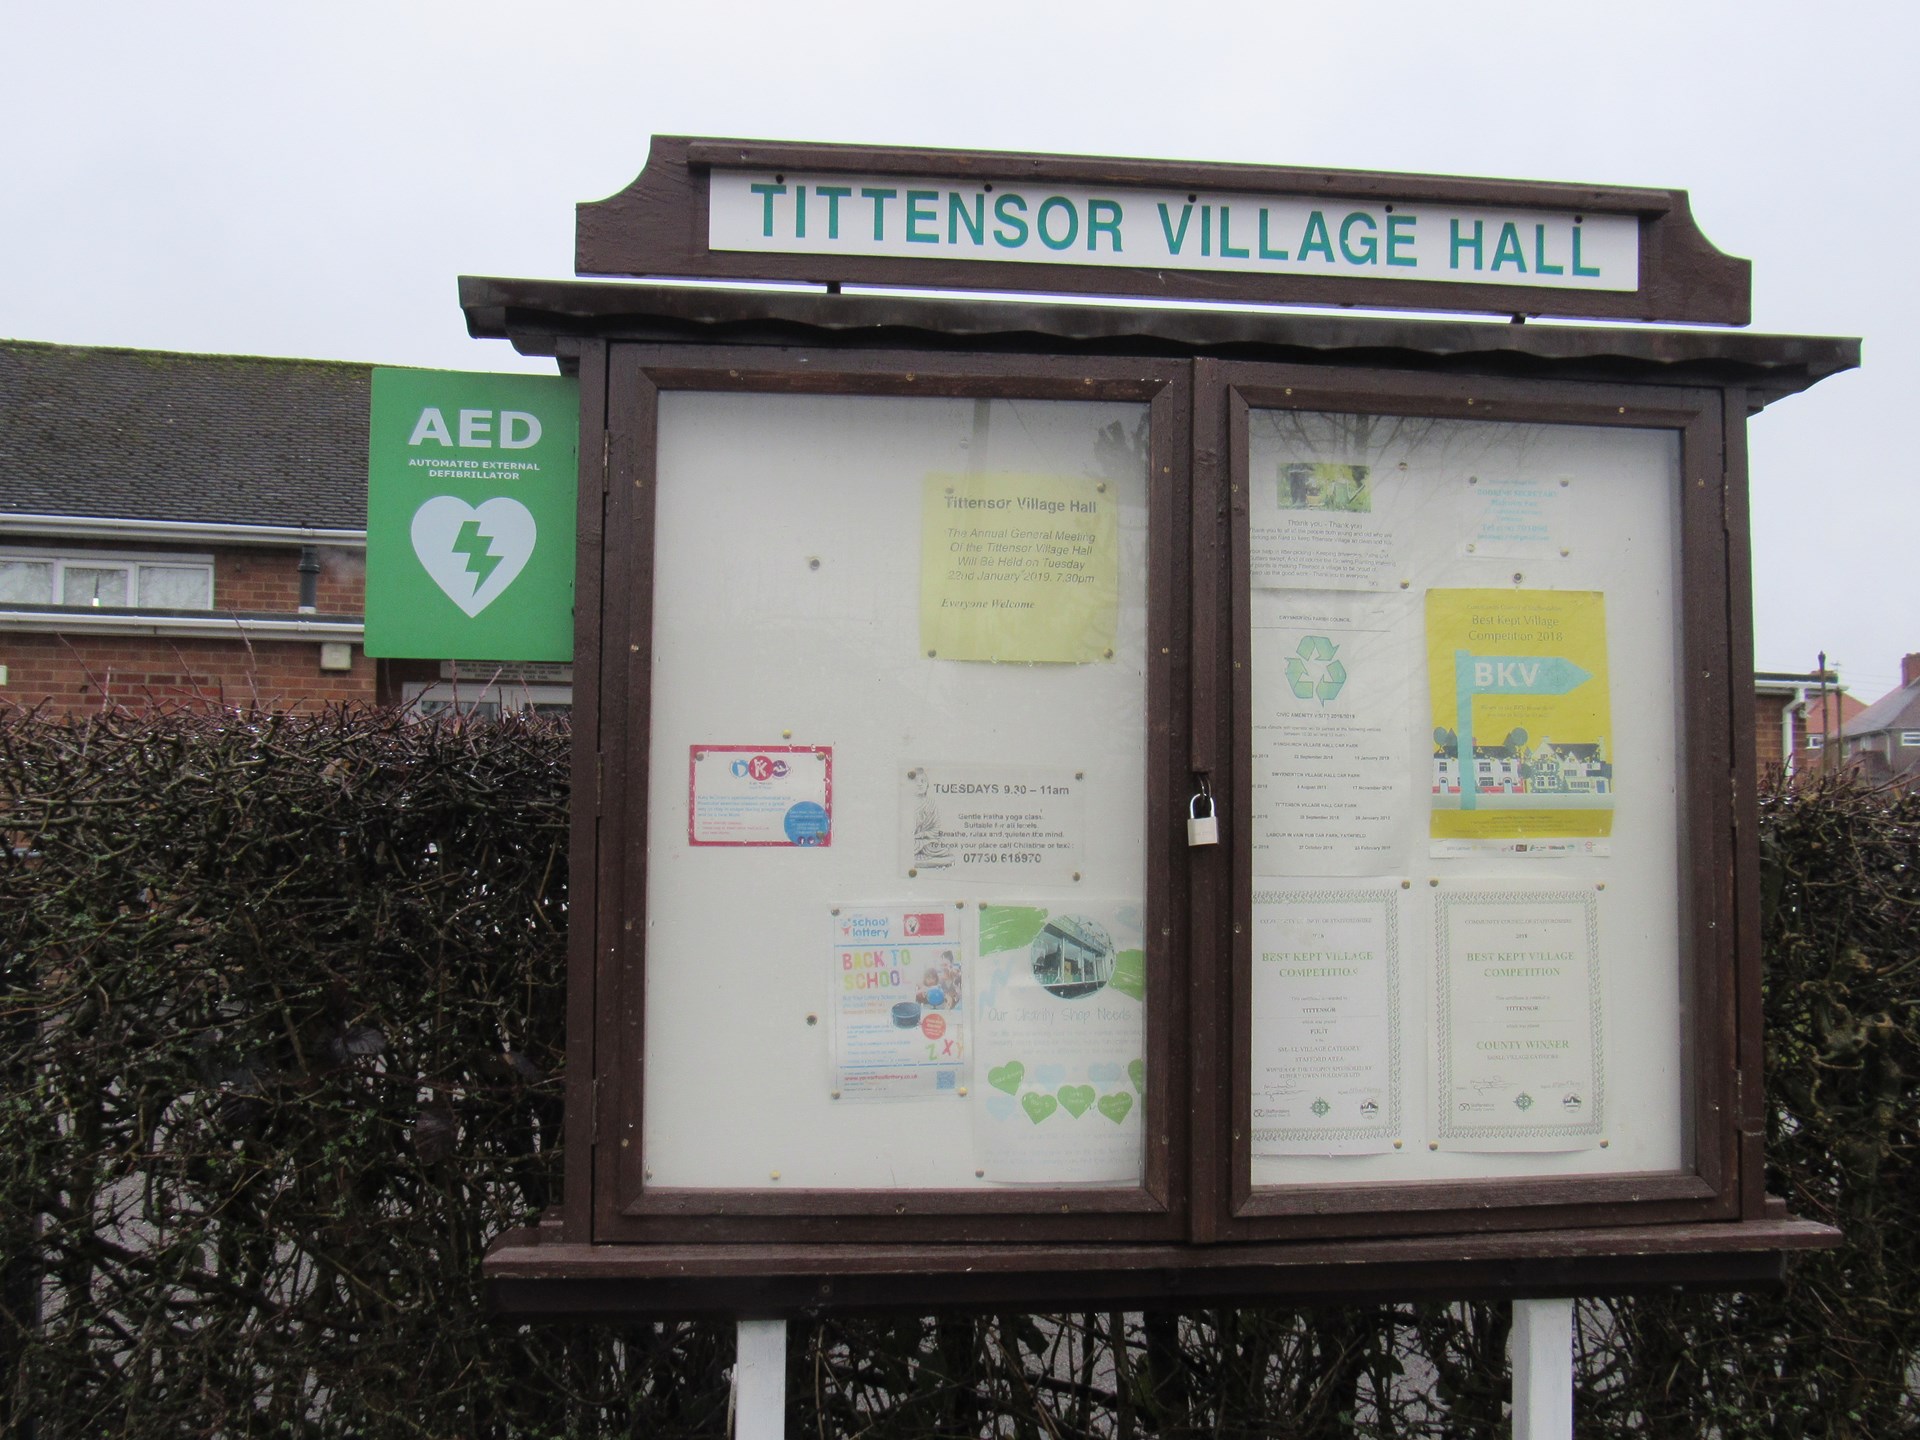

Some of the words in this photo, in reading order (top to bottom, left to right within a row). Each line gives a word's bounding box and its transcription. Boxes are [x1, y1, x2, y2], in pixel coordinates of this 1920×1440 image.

[750, 182, 1124, 252] TITTENSOR
[1156, 202, 1418, 268] VILLAGE
[1450, 218, 1600, 278] HALL
[408, 408, 542, 450] AED
[408, 458, 479, 470] AUTOMATED
[482, 460, 540, 472] EXTERNAL
[428, 470, 520, 480] DEFIBRILLATOR
[944, 496, 1012, 510] Tittensor
[1016, 496, 1066, 514] Village
[1070, 500, 1096, 514] Hall
[948, 528, 967, 538] The
[970, 528, 1008, 538] Annual
[1010, 528, 1053, 540] General
[1055, 530, 1096, 544] Meeting
[950, 542, 961, 552] Of
[966, 542, 983, 552] the
[986, 542, 1032, 553] Tittensor
[1036, 544, 1068, 556] Village
[1072, 545, 1093, 556] Hall
[958, 557, 976, 567] Will
[980, 557, 994, 567] Be
[998, 557, 1022, 567] Held
[1026, 559, 1038, 568] on
[1042, 558, 1085, 572] Tuesday
[947, 570, 974, 581] 22nd
[977, 571, 1020, 583] January
[1056, 572, 1095, 584] 7.30pm
[941, 598, 988, 610] Everyone
[991, 599, 1036, 609] Welcome
[1472, 615, 1494, 625] Best
[1497, 616, 1521, 626] Kept
[1524, 616, 1559, 628] Village
[1468, 630, 1533, 643] Competition
[1537, 632, 1563, 642] 2018
[1474, 662, 1540, 687] BKV
[933, 784, 999, 794] TUESDAYS
[1004, 785, 1027, 796] 9.30
[1040, 785, 1070, 795] 11am
[1005, 814, 1023, 822] yoga
[978, 842, 998, 850] place
[1000, 853, 1042, 863] 618970
[852, 916, 888, 927] school
[852, 928, 889, 938] lottery
[842, 950, 886, 970] BACK
[890, 949, 911, 966] TO
[1262, 952, 1290, 962] BEST
[1293, 952, 1323, 962] KEPT
[1466, 952, 1495, 962] BEST
[1498, 952, 1526, 961] KEPT
[1528, 952, 1575, 961] VILLAGE
[1484, 968, 1560, 978] COMPETITION
[843, 970, 912, 990] SCHOOL
[988, 1008, 1008, 1022] Our
[1060, 1008, 1090, 1024] Shop
[1097, 1008, 1131, 1021] Needs
[1476, 1040, 1521, 1050] COUNTY
[1525, 1040, 1569, 1049] WINNER
